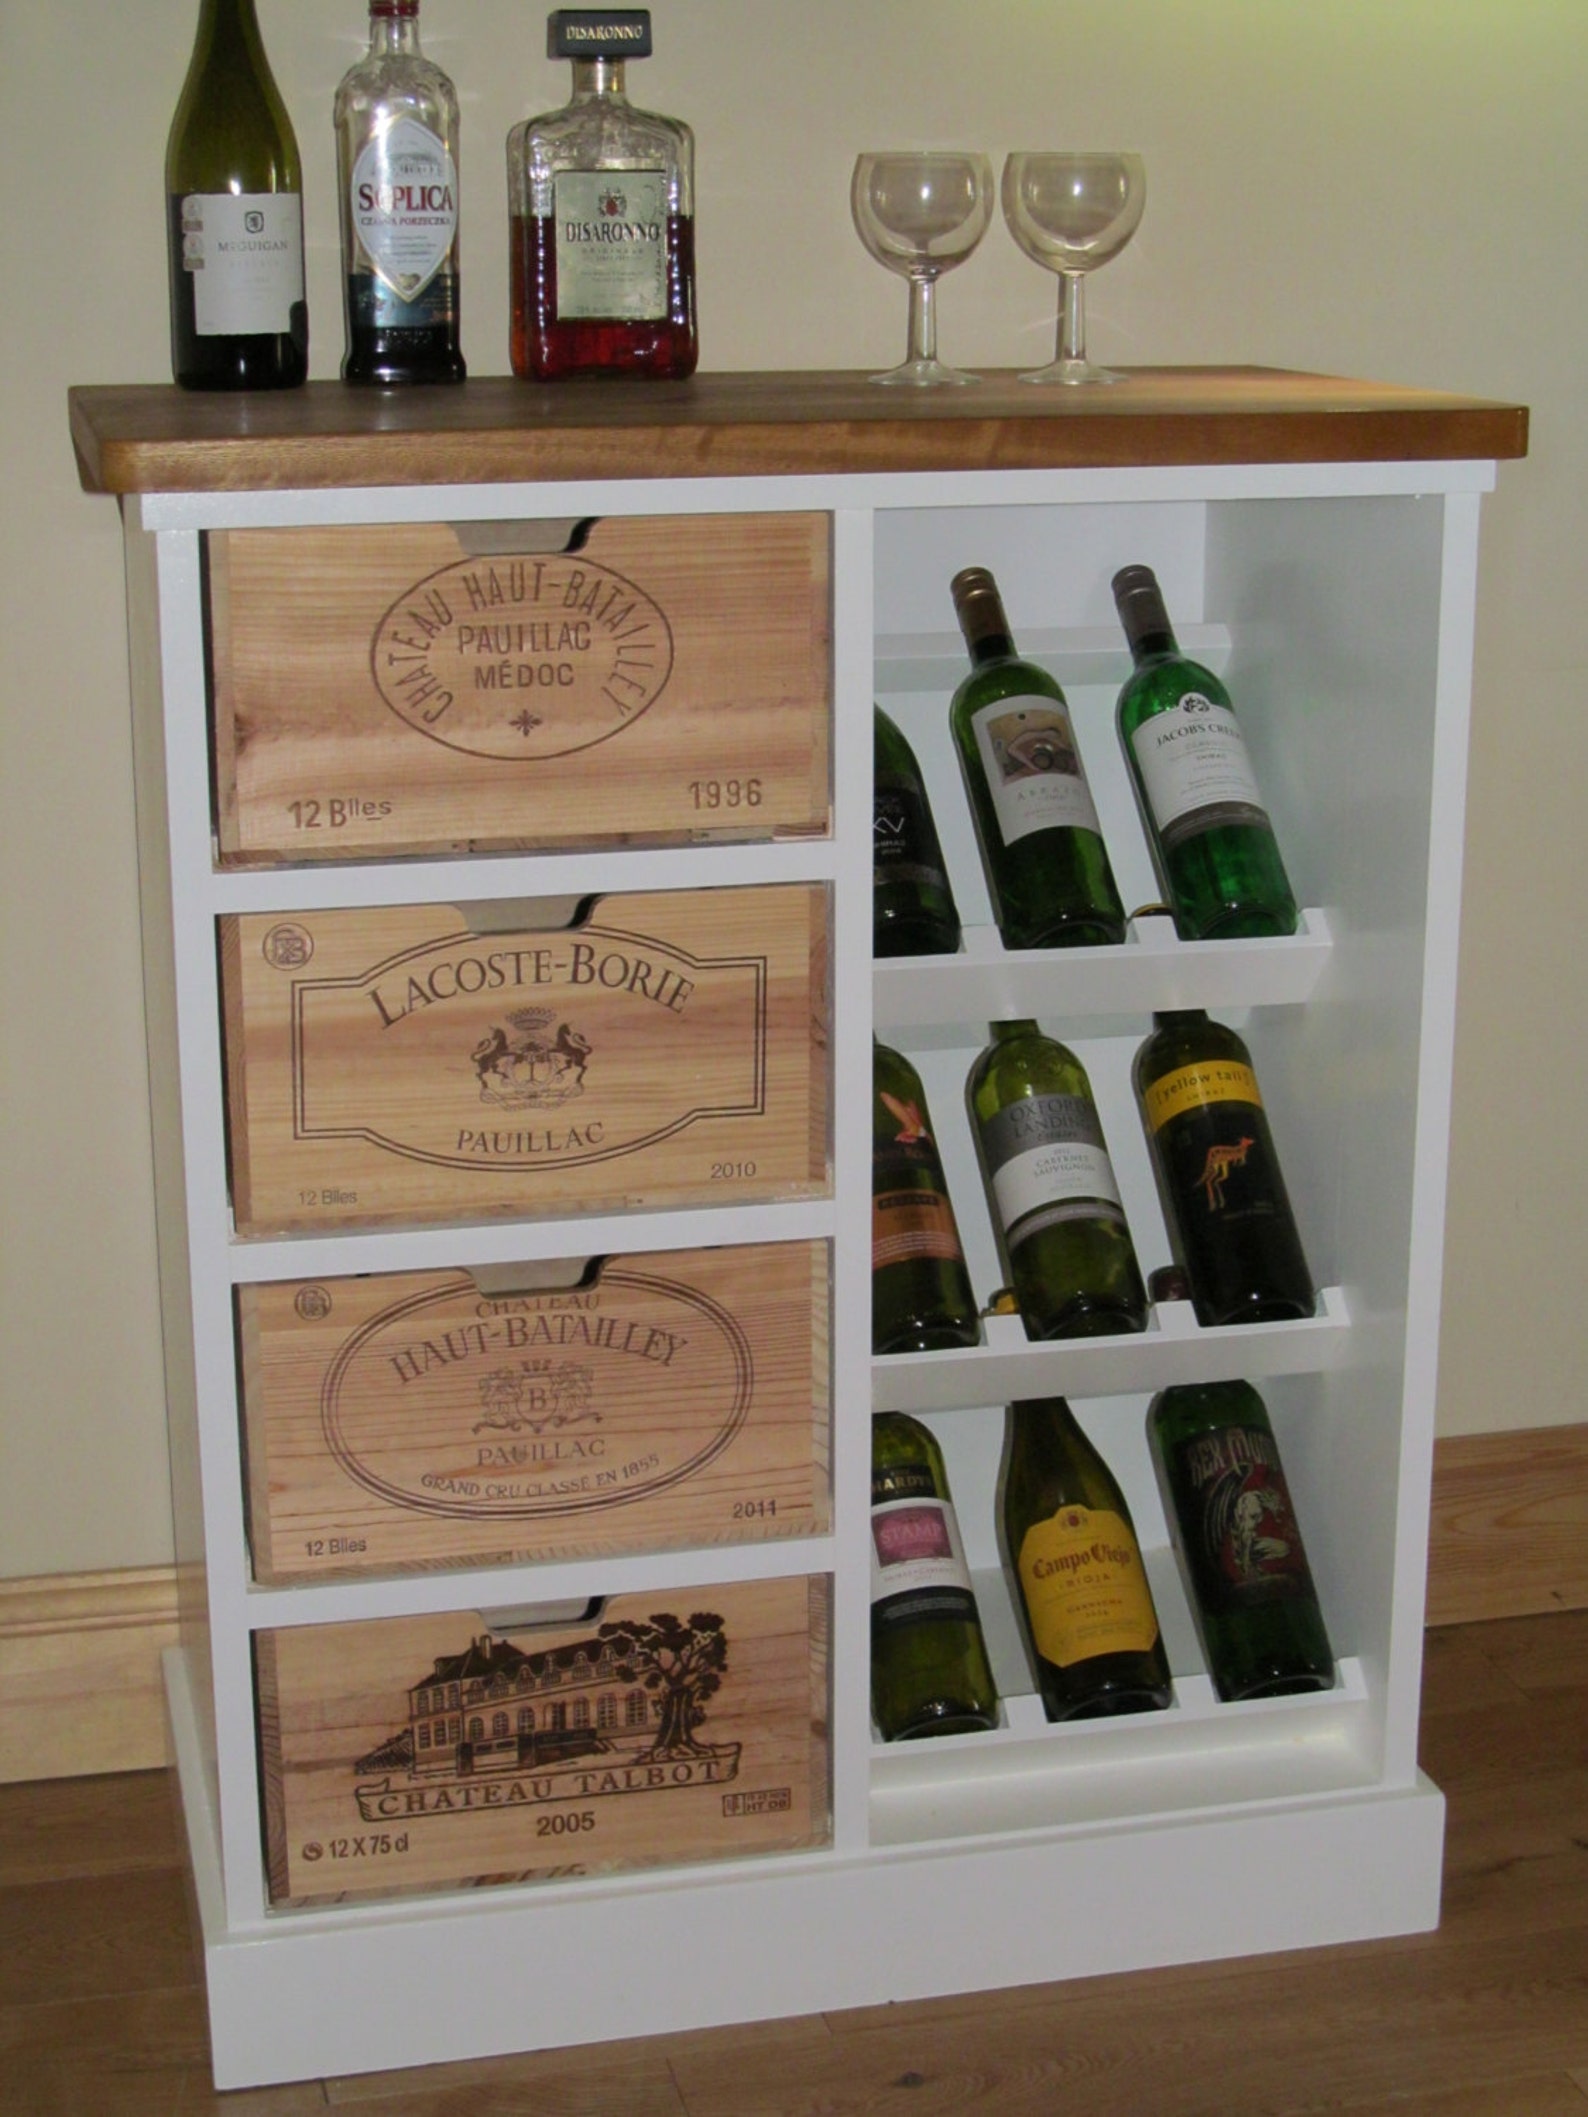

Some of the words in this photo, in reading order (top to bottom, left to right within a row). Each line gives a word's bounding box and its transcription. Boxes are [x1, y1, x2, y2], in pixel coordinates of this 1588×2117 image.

[565, 25, 643, 40] DISARONNO
[565, 222, 660, 243] DISARONNO
[389, 588, 454, 724] CHATEAU
[462, 561, 656, 717] HAUT-BATAILLEY
[457, 620, 592, 655] PAUILLAC
[474, 659, 575, 690] MÉDOC
[688, 778, 763, 810] 1996
[287, 799, 322, 829] 12
[366, 942, 696, 1031] LACOSTE-BORIE
[456, 1121, 605, 1155] PAUILLAC
[710, 1161, 757, 1180] 2010
[298, 1189, 318, 1206] 12
[389, 1312, 688, 1385] HAUT-BATAILLEY
[477, 1438, 606, 1467] PAUILLAC
[420, 1473, 480, 1498] GRAND
[485, 1483, 521, 1499] CRU
[595, 1469, 618, 1487] EN
[622, 1453, 661, 1479] 1855
[733, 1498, 778, 1519] 2011
[305, 1541, 324, 1557] 12
[1032, 1549, 1091, 1579] Campo
[377, 1779, 552, 1816] CHATEAU
[574, 1761, 722, 1794] TALBOT
[536, 1811, 596, 1837] 2005
